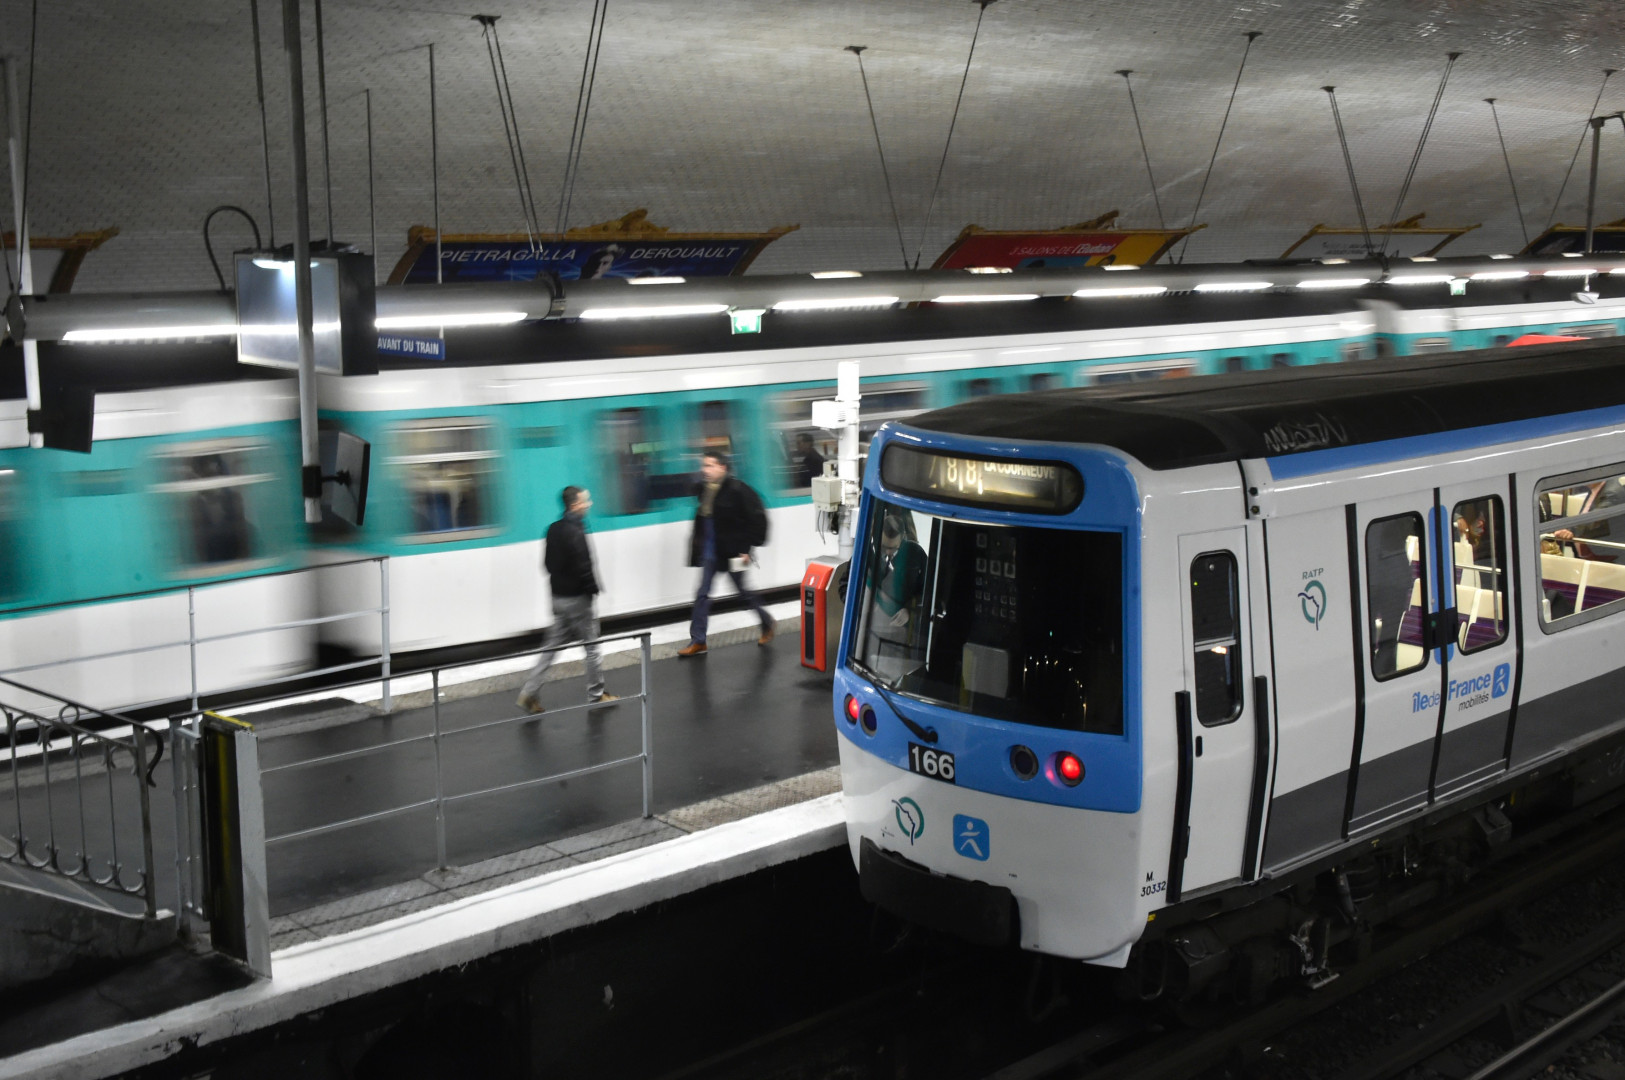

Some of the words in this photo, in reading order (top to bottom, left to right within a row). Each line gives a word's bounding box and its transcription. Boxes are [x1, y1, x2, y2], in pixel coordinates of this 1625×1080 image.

[440, 248, 577, 262] PIETRAGALLA
[630, 247, 739, 260] DEROUAULT
[377, 337, 402, 351] AVANT
[403, 339, 415, 353] DU
[416, 341, 440, 355] TRAIN
[1302, 567, 1324, 580] RATP
[1447, 673, 1492, 702] France
[1458, 691, 1490, 712] mobilités
[911, 746, 955, 780] 166
[1140, 880, 1167, 897] 30332
